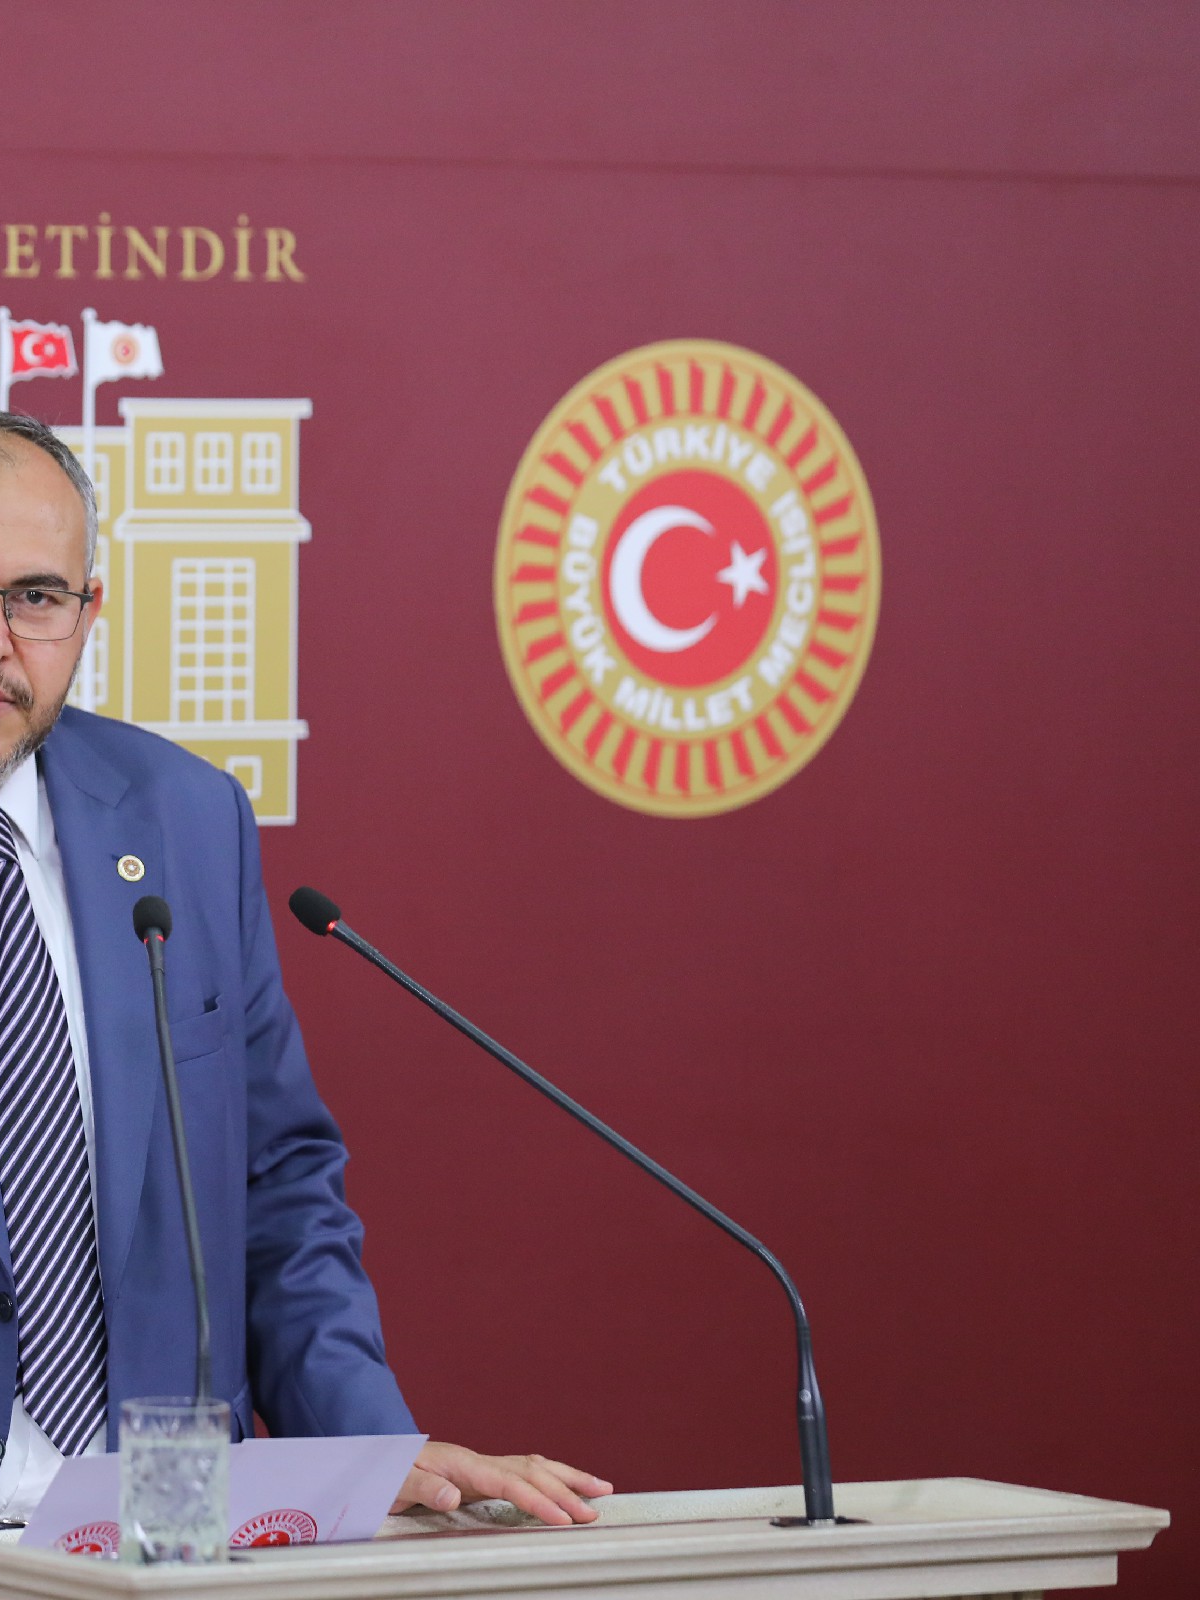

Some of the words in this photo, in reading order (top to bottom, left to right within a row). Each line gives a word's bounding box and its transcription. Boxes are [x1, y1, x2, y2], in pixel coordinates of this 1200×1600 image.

[599, 423, 778, 493] TÜRKİYE
[562, 513, 618, 686] BÜYÜK
[613, 675, 755, 731] MİLLET
